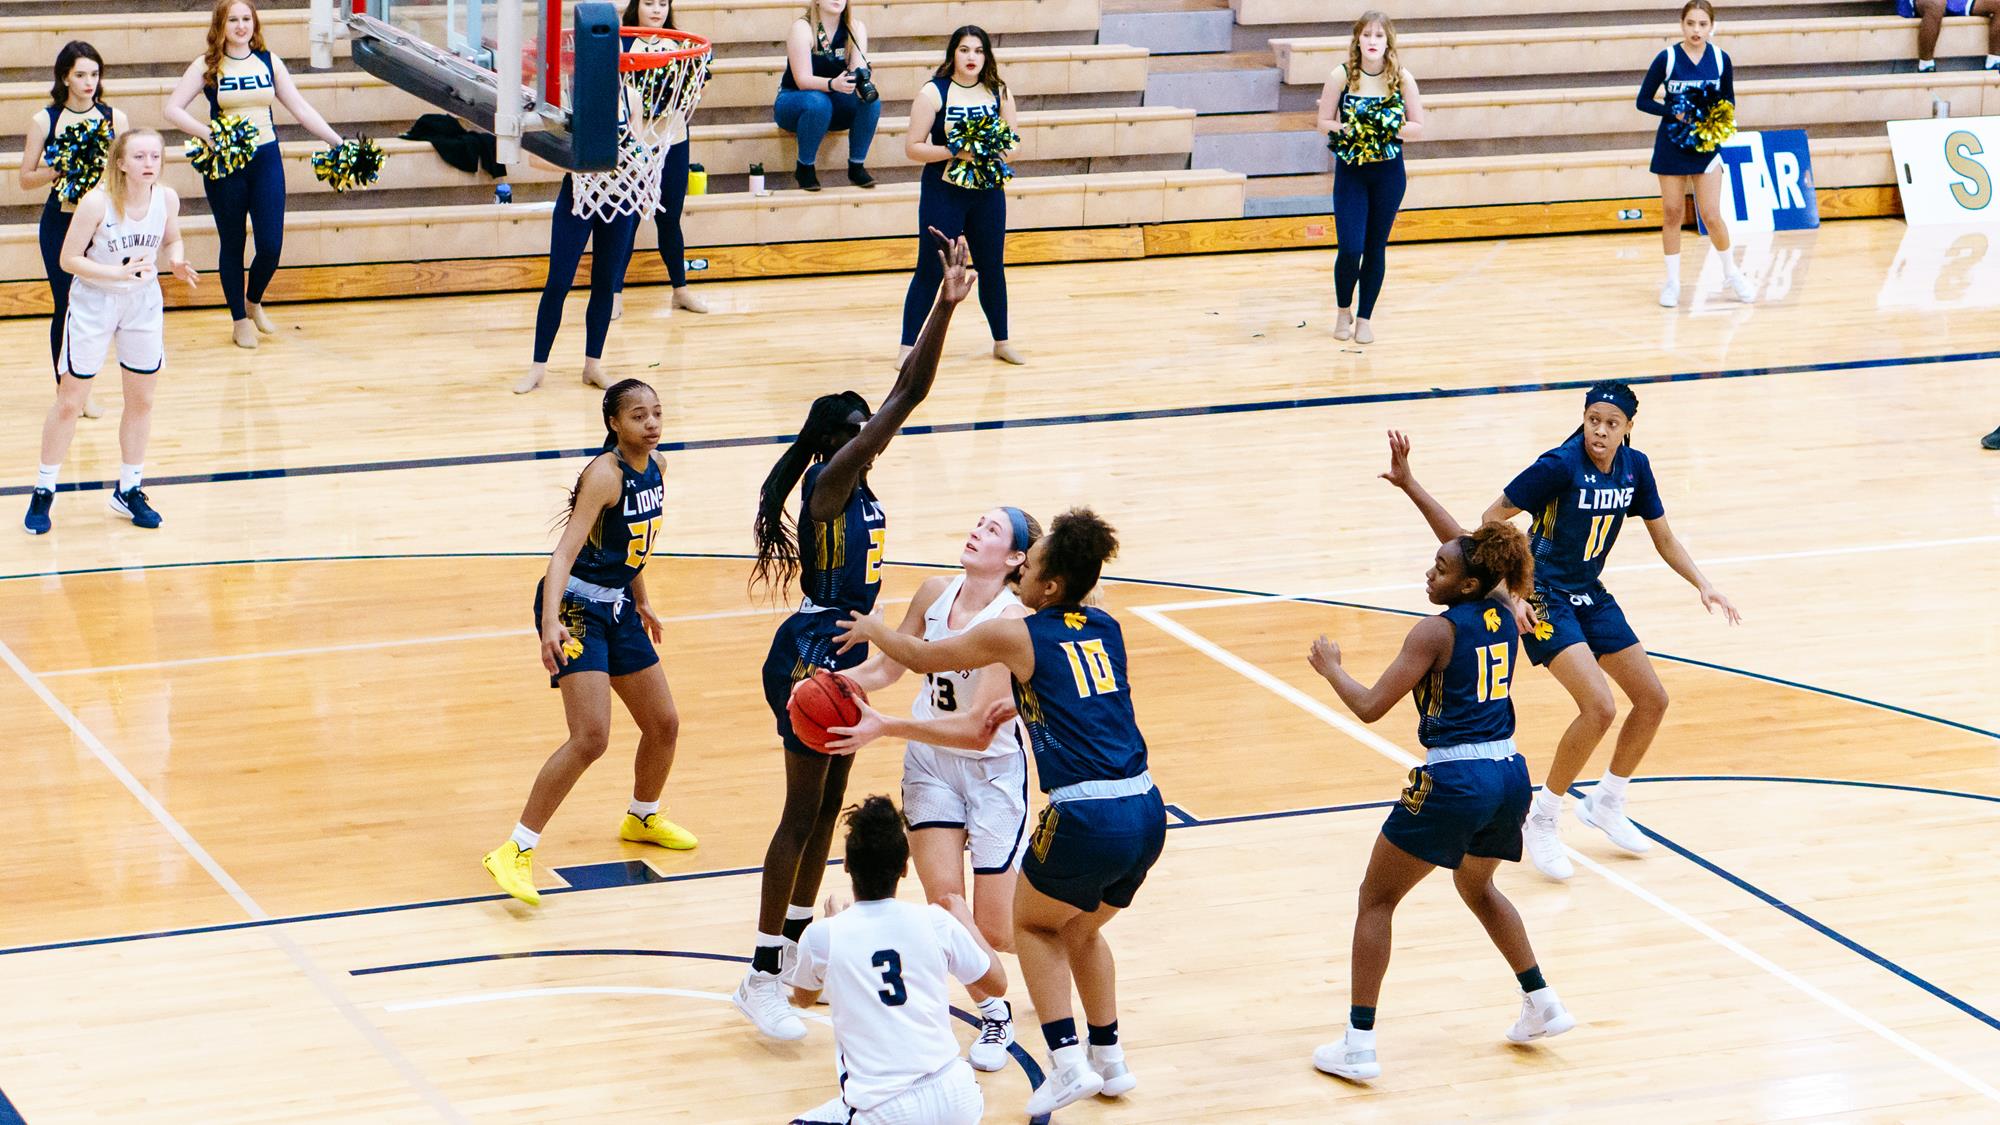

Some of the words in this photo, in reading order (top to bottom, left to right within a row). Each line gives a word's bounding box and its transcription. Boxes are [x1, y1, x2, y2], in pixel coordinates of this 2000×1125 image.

[219, 73, 273, 91] SEU
[1944, 130, 1993, 211] S
[1578, 488, 1635, 510] LIONS
[1583, 515, 1615, 561] 11
[1059, 638, 1119, 698] 10
[1475, 642, 1508, 703] 12
[871, 949, 907, 1006] 3
